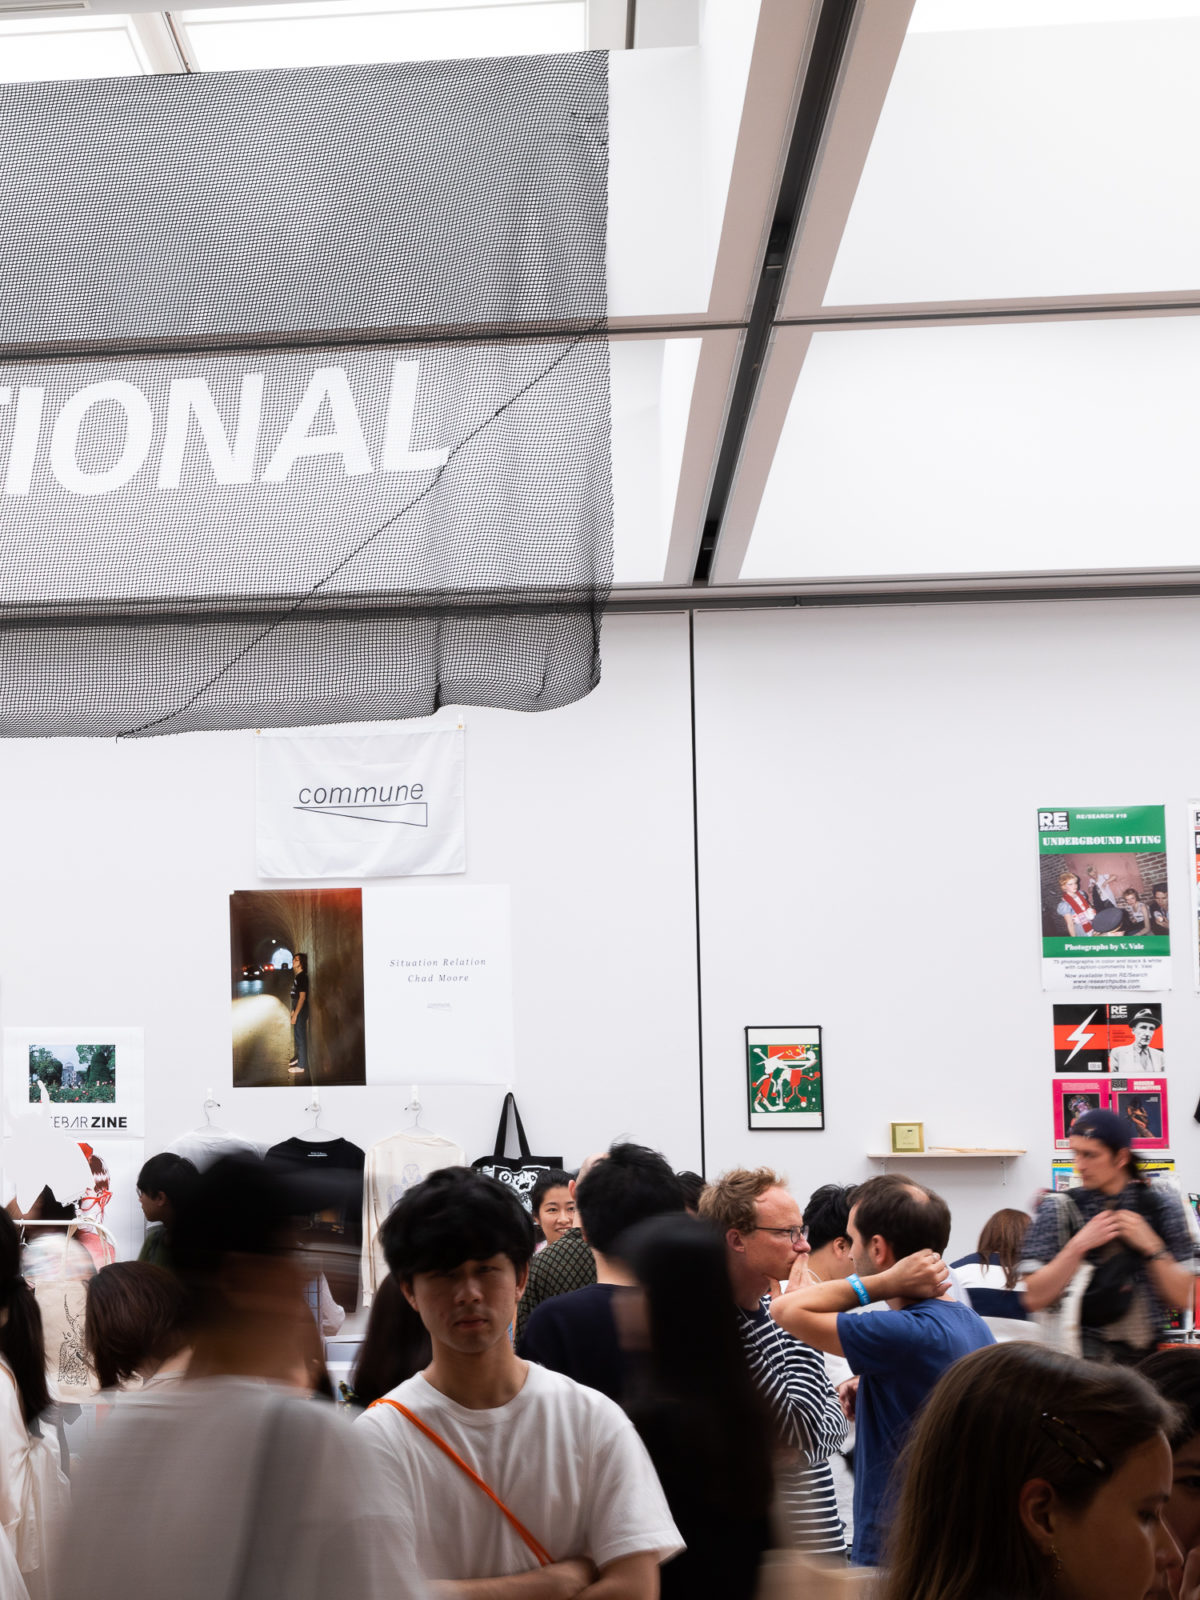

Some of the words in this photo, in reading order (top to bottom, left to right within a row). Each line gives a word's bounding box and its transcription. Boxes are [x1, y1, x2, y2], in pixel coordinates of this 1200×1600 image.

[298, 783, 424, 804] commune
[1038, 812, 1068, 826] RE
[1042, 836, 1123, 846] UNDERGROUND
[1125, 835, 1162, 845] LIVING
[1064, 943, 1109, 952] Photographs
[1110, 943, 1118, 951] by
[389, 958, 438, 968] Situation
[443, 957, 486, 967] Relation
[407, 974, 434, 983] Chad
[439, 974, 469, 983] Moore
[1111, 1005, 1128, 1014] RE
[91, 1116, 128, 1128] ZINE
